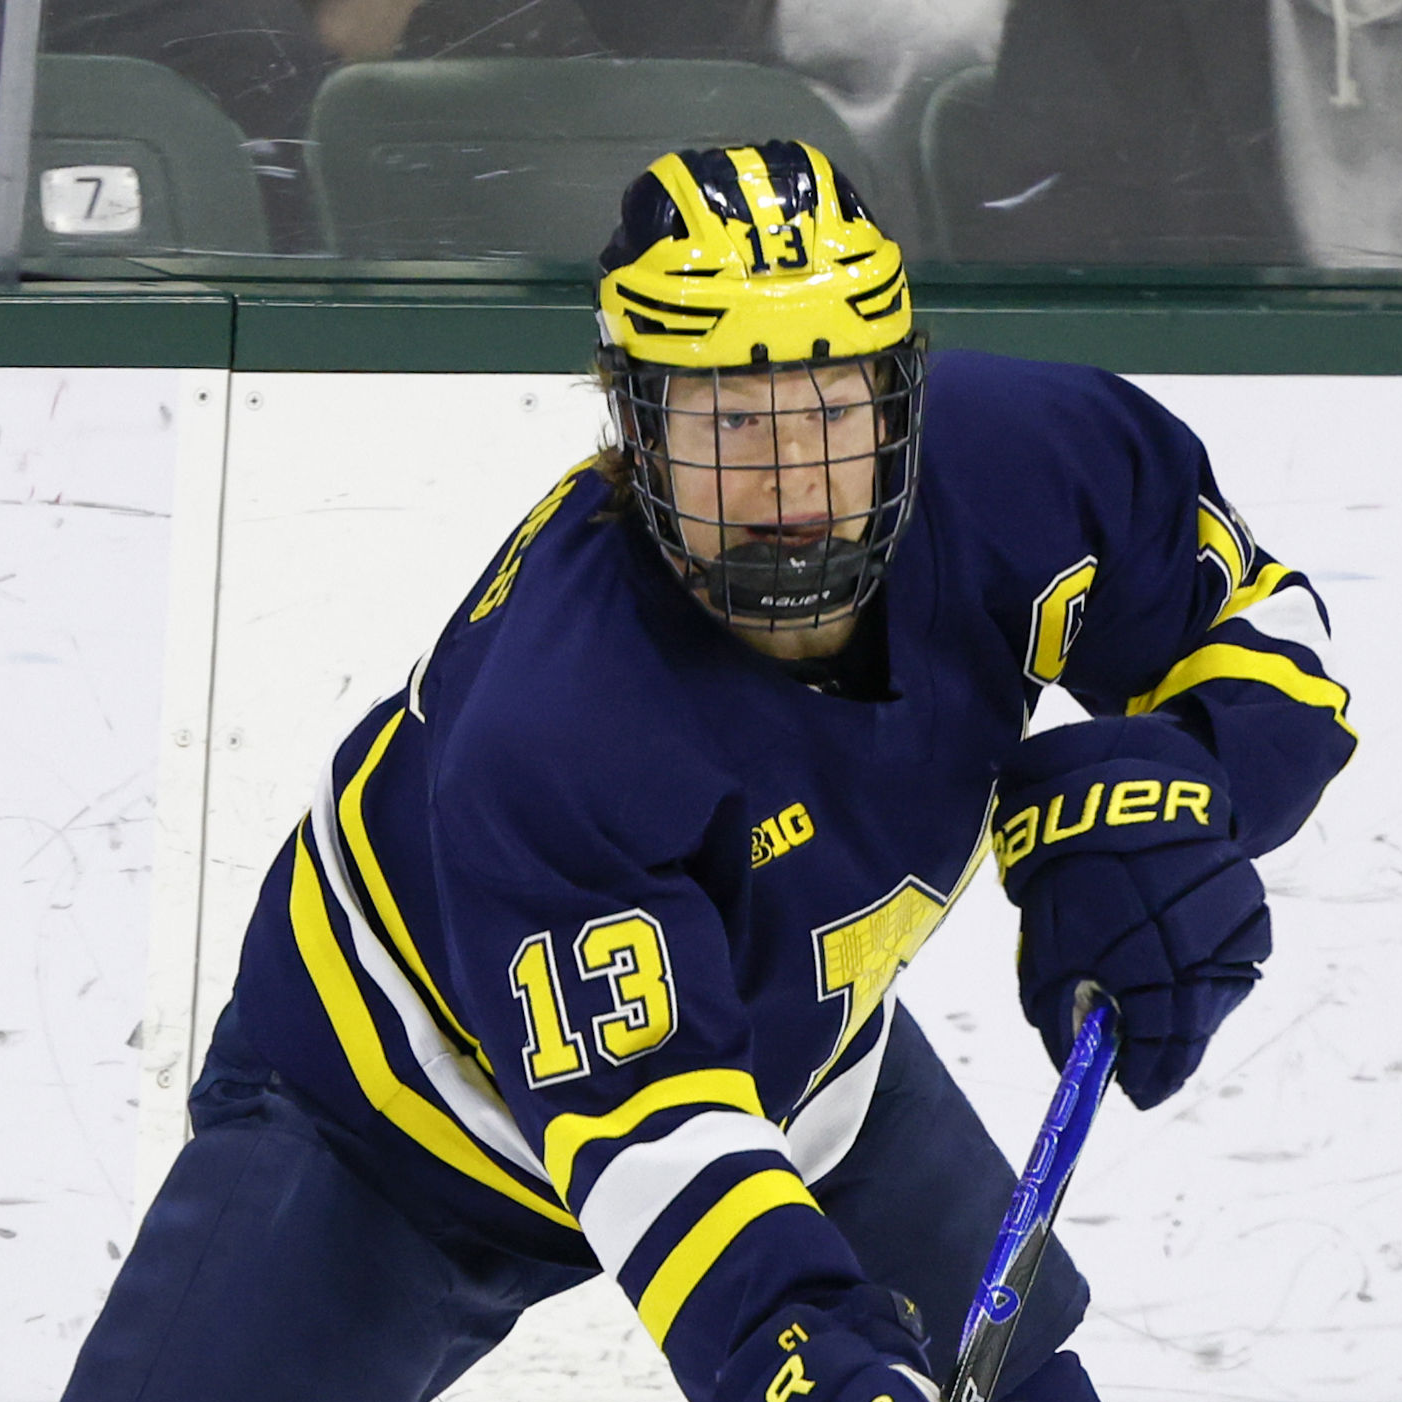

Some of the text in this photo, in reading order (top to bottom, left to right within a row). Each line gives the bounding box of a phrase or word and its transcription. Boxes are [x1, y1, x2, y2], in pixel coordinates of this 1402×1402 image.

[75, 176, 105, 219] 7
[745, 223, 808, 273] 13
[1023, 554, 1099, 687] C
[508, 906, 678, 1089] 13
